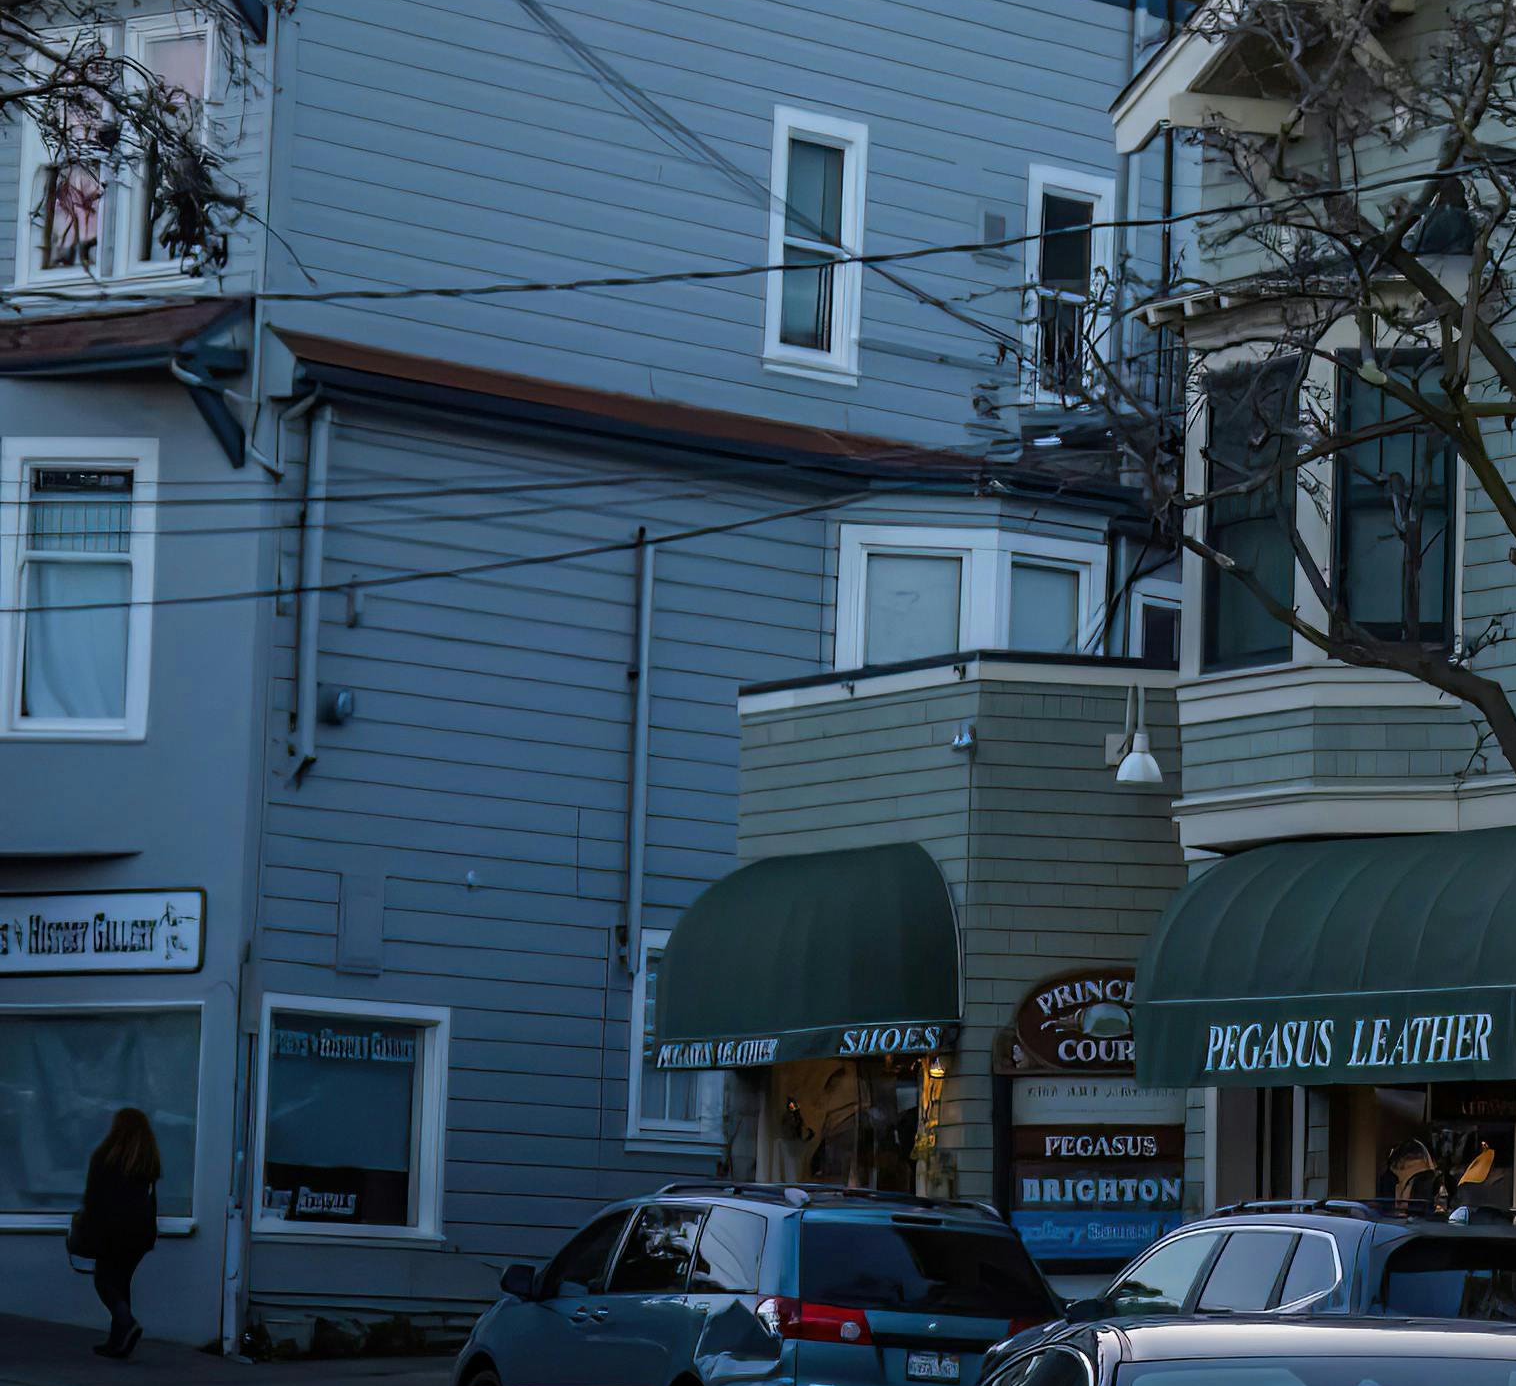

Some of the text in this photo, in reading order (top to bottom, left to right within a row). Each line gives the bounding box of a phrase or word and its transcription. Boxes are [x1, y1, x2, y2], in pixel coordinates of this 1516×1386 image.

[840, 1027, 940, 1054] SHOES
[1204, 1013, 1493, 1072] PEGASUS LEATHER
[1044, 1135, 1158, 1158] PEGASUS
[1022, 1177, 1181, 1203] BRIGHTON
